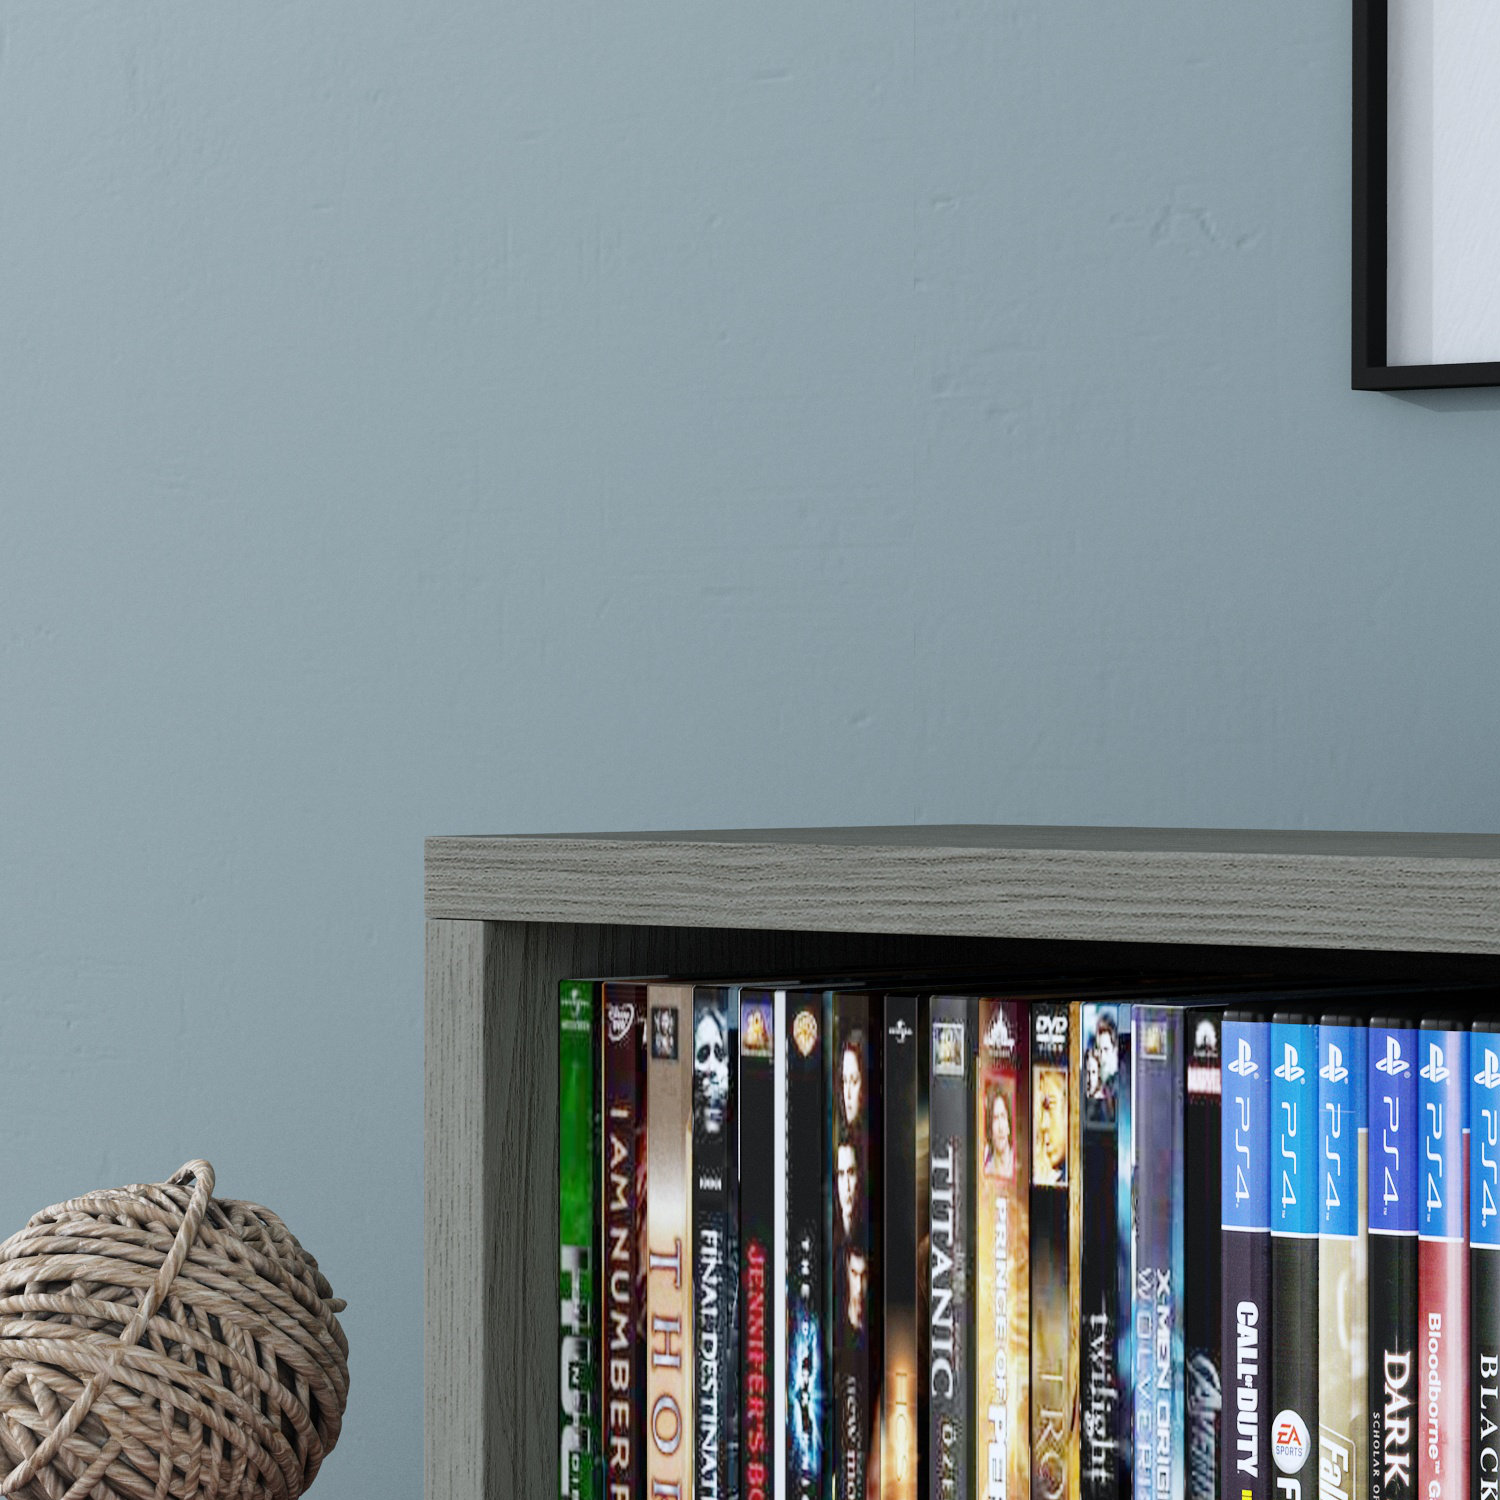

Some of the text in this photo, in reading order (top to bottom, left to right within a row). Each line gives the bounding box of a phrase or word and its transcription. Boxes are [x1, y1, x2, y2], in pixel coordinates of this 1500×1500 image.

[610, 1107, 629, 1118] I
[610, 1133, 629, 1212] AM
[700, 1230, 718, 1329] FINAL
[931, 1144, 953, 1400] TITANIC
[995, 1197, 1007, 1341] PRINCE
[609, 1227, 630, 1469] NUMBER
[747, 1243, 766, 1453] JENNIFER'S
[995, 1349, 1007, 1402] OF
[1156, 1267, 1171, 1390] X-MEN
[1236, 1301, 1259, 1380] CALL
[1084, 1310, 1120, 1484] twilight
[1236, 1387, 1259, 1478] DUTY
[1276, 1423, 1301, 1446] EA
[1372, 1411, 1380, 1477] SCHOLAR
[1384, 1349, 1411, 1488] DARK
[1275, 1445, 1303, 1457] SPORTS
